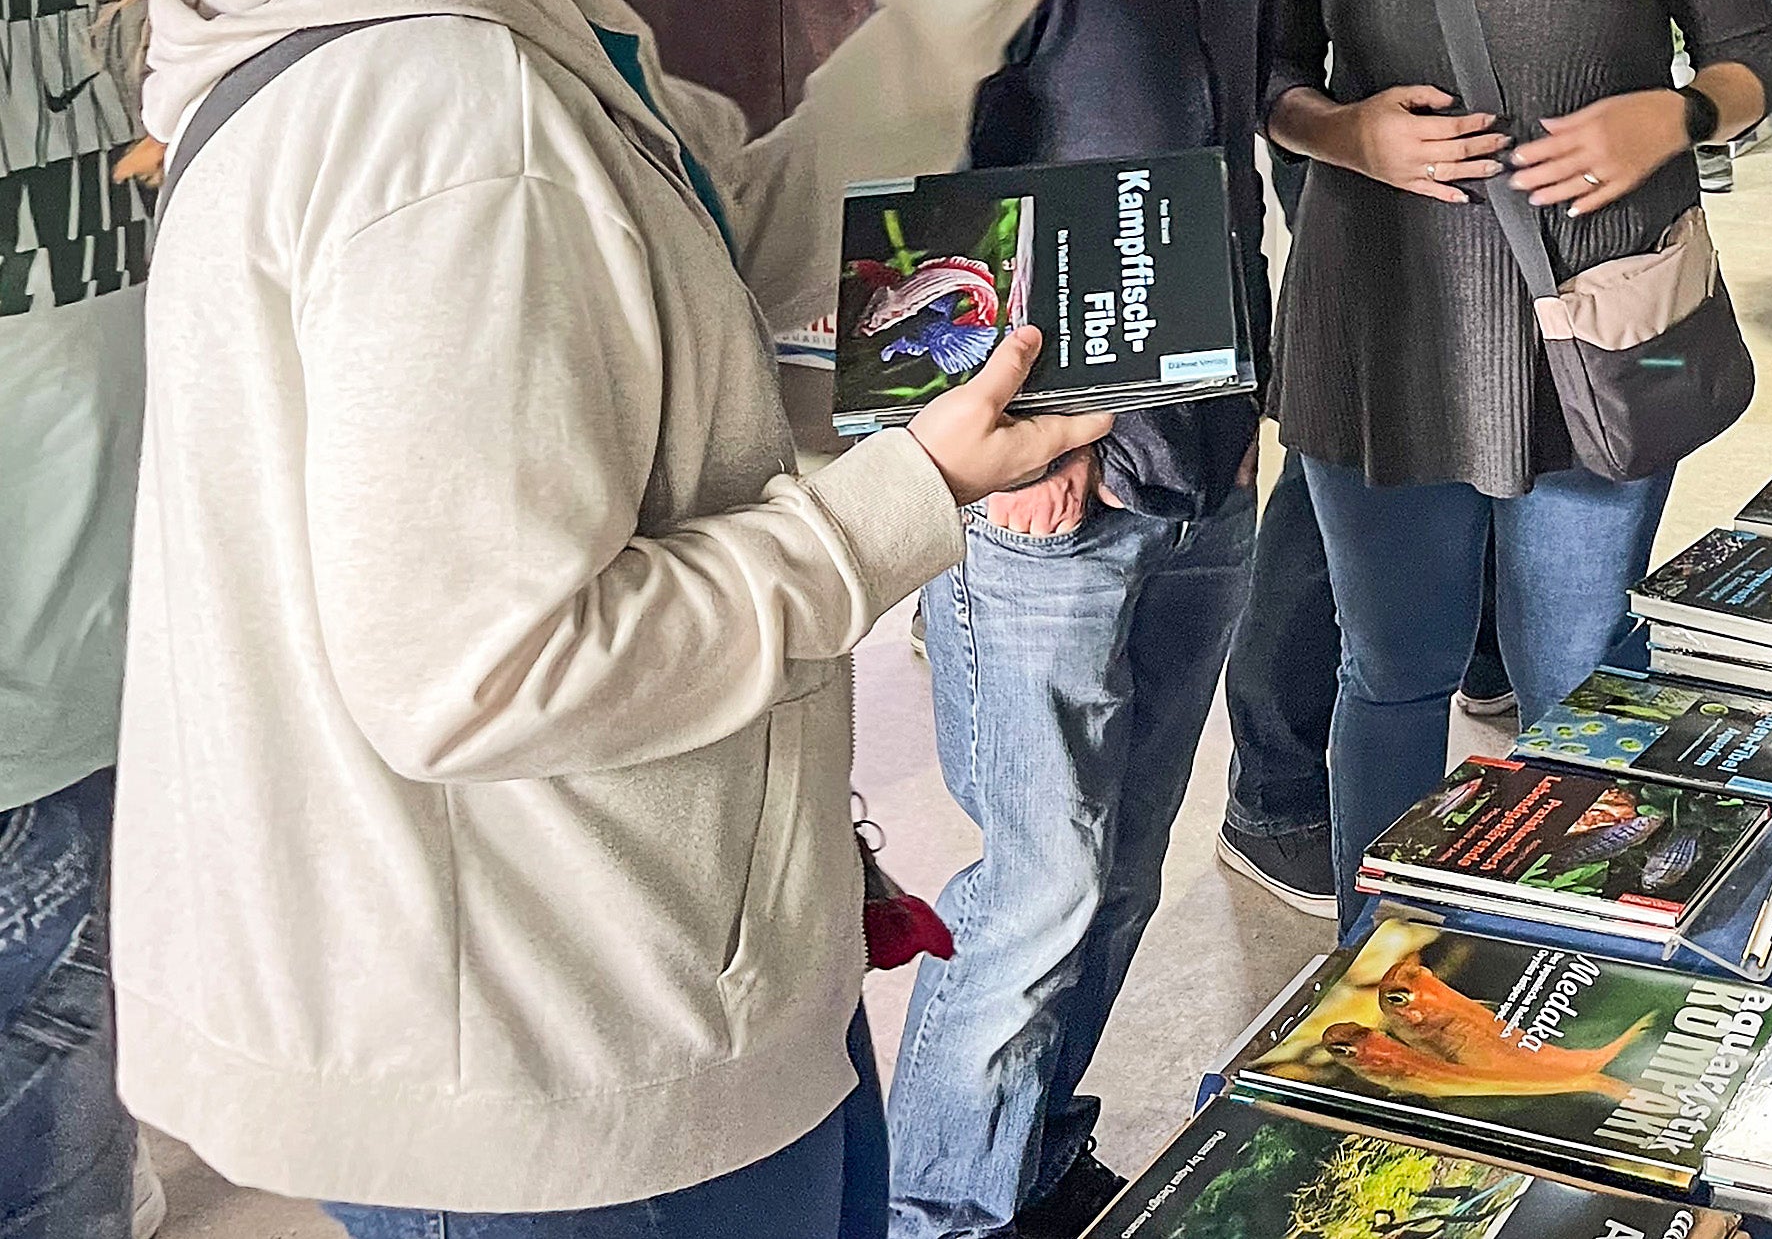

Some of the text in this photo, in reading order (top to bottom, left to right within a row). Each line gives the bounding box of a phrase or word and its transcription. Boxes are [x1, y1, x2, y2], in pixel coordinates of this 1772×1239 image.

[1113, 169, 1158, 353] Kampffisch-
[1083, 291, 1118, 366] Fibel
[1480, 798, 1563, 871] Praxishandbuch
[1517, 953, 1601, 1054] Medaka
[1593, 980, 1746, 1149] KOMPAKT
[1145, 1184, 1177, 1212] Design
